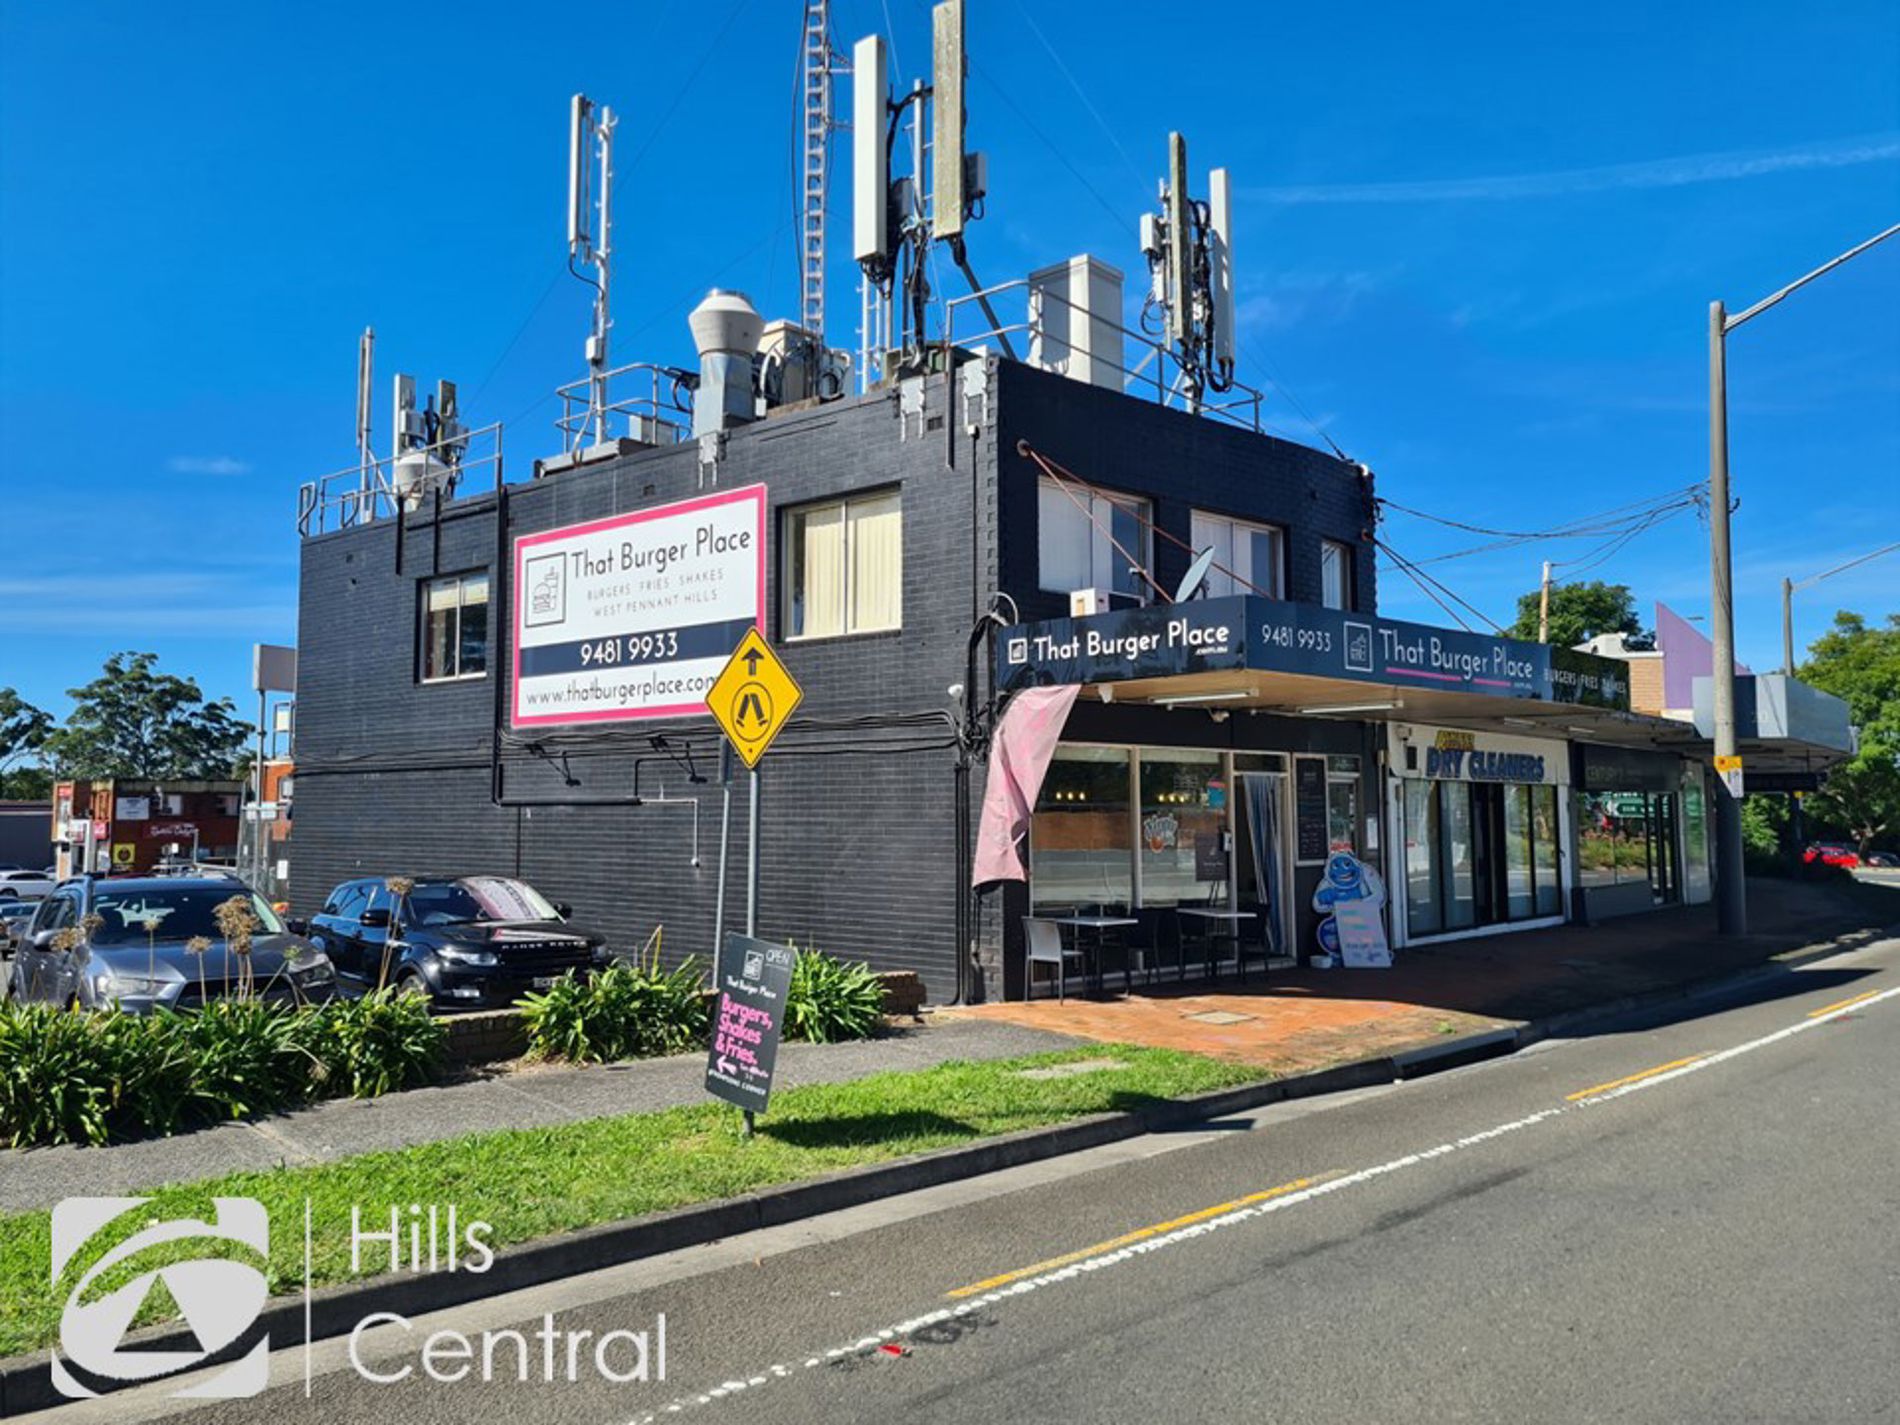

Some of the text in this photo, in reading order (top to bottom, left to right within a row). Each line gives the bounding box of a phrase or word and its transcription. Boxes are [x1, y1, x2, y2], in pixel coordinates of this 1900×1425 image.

[571, 523, 751, 579] That Burger Place
[587, 568, 723, 600] BURGERS FRIES SHAKES
[594, 589, 718, 617] WEST PENNANT HILLS
[580, 631, 679, 666] 9481 9933
[1033, 617, 1229, 662] That Burger Place
[1262, 624, 1331, 652] 9481 9933
[1378, 628, 1533, 680] That Burger Place
[1426, 746, 1545, 783] DRY CLEANERS
[718, 1013, 762, 1045] Shakes
[721, 992, 773, 1030] Burgers,
